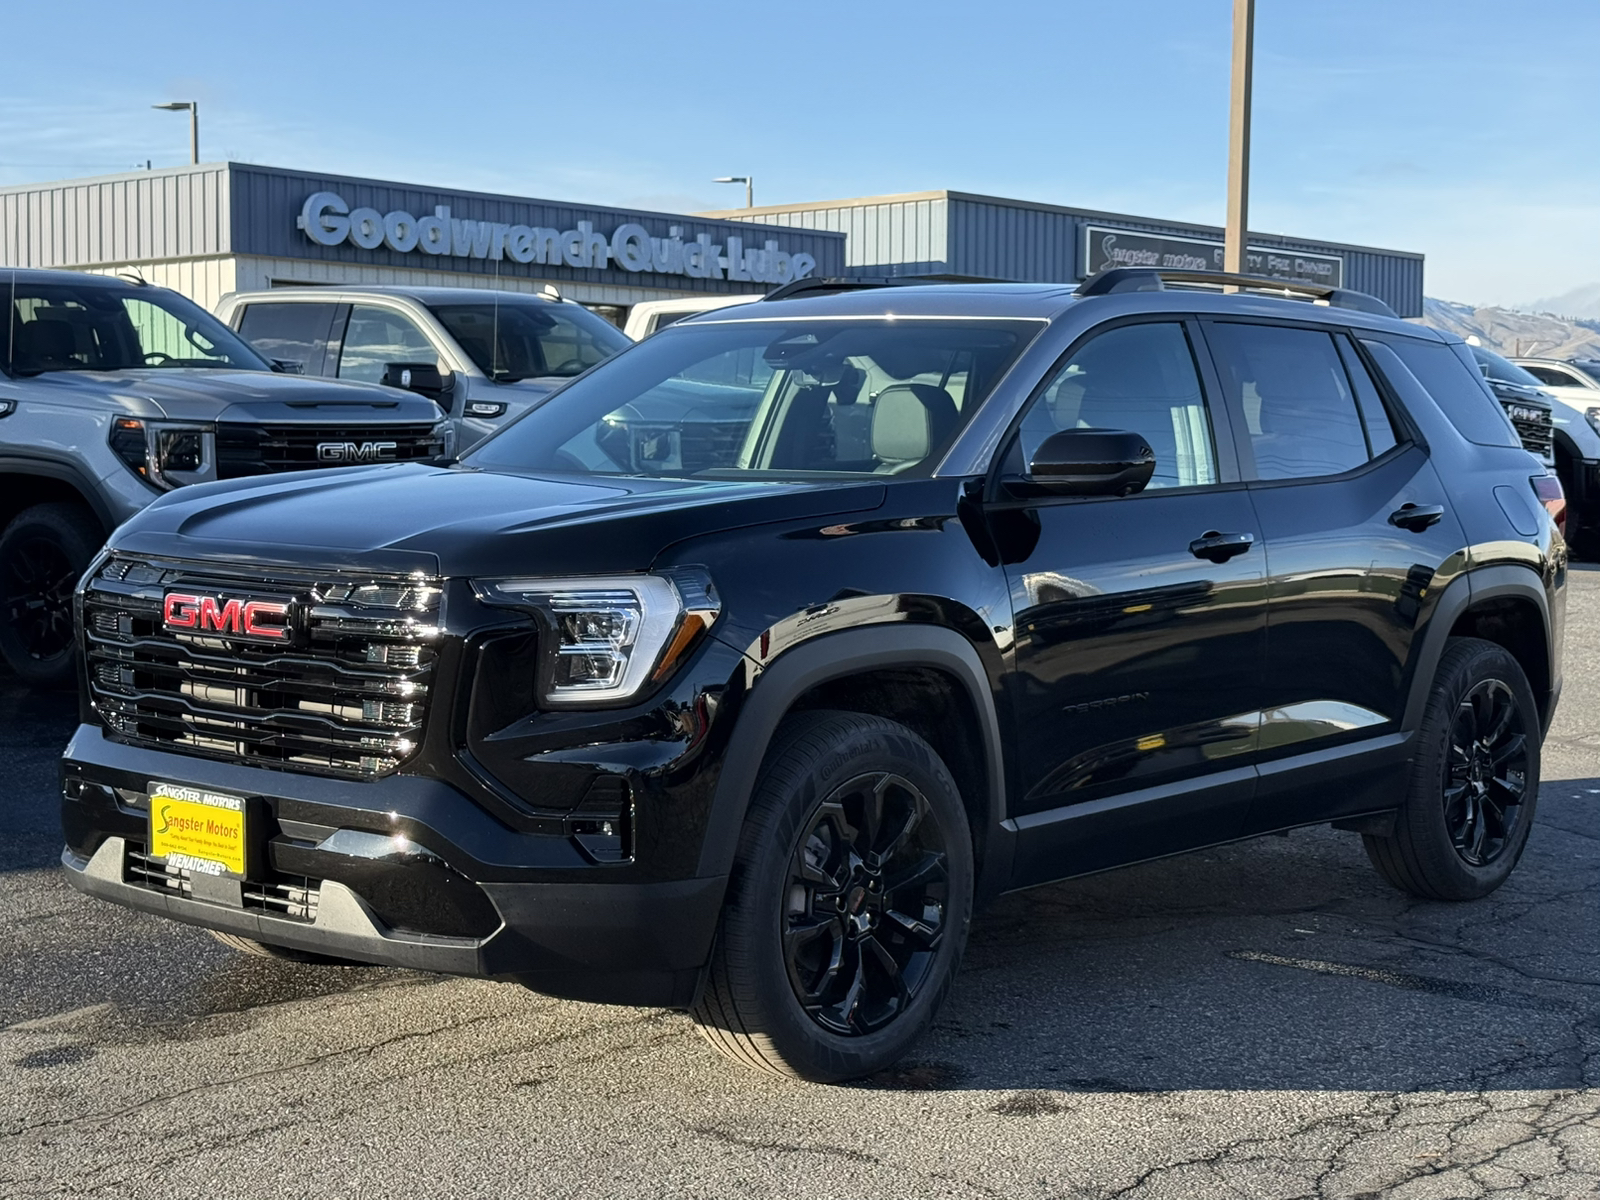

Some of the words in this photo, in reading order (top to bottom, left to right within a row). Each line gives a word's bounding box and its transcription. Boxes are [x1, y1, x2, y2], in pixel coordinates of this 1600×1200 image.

[301, 191, 607, 269] Goodwrench
[611, 223, 722, 279] Quick
[727, 236, 816, 285] Lube
[316, 442, 397, 461] GMC
[164, 593, 288, 637] GMC
[153, 784, 202, 804] SANGSTER
[203, 793, 241, 811] MOTORS
[157, 805, 204, 834] Sangster
[206, 819, 239, 840] Motors
[168, 852, 221, 877] WENATCHEE
